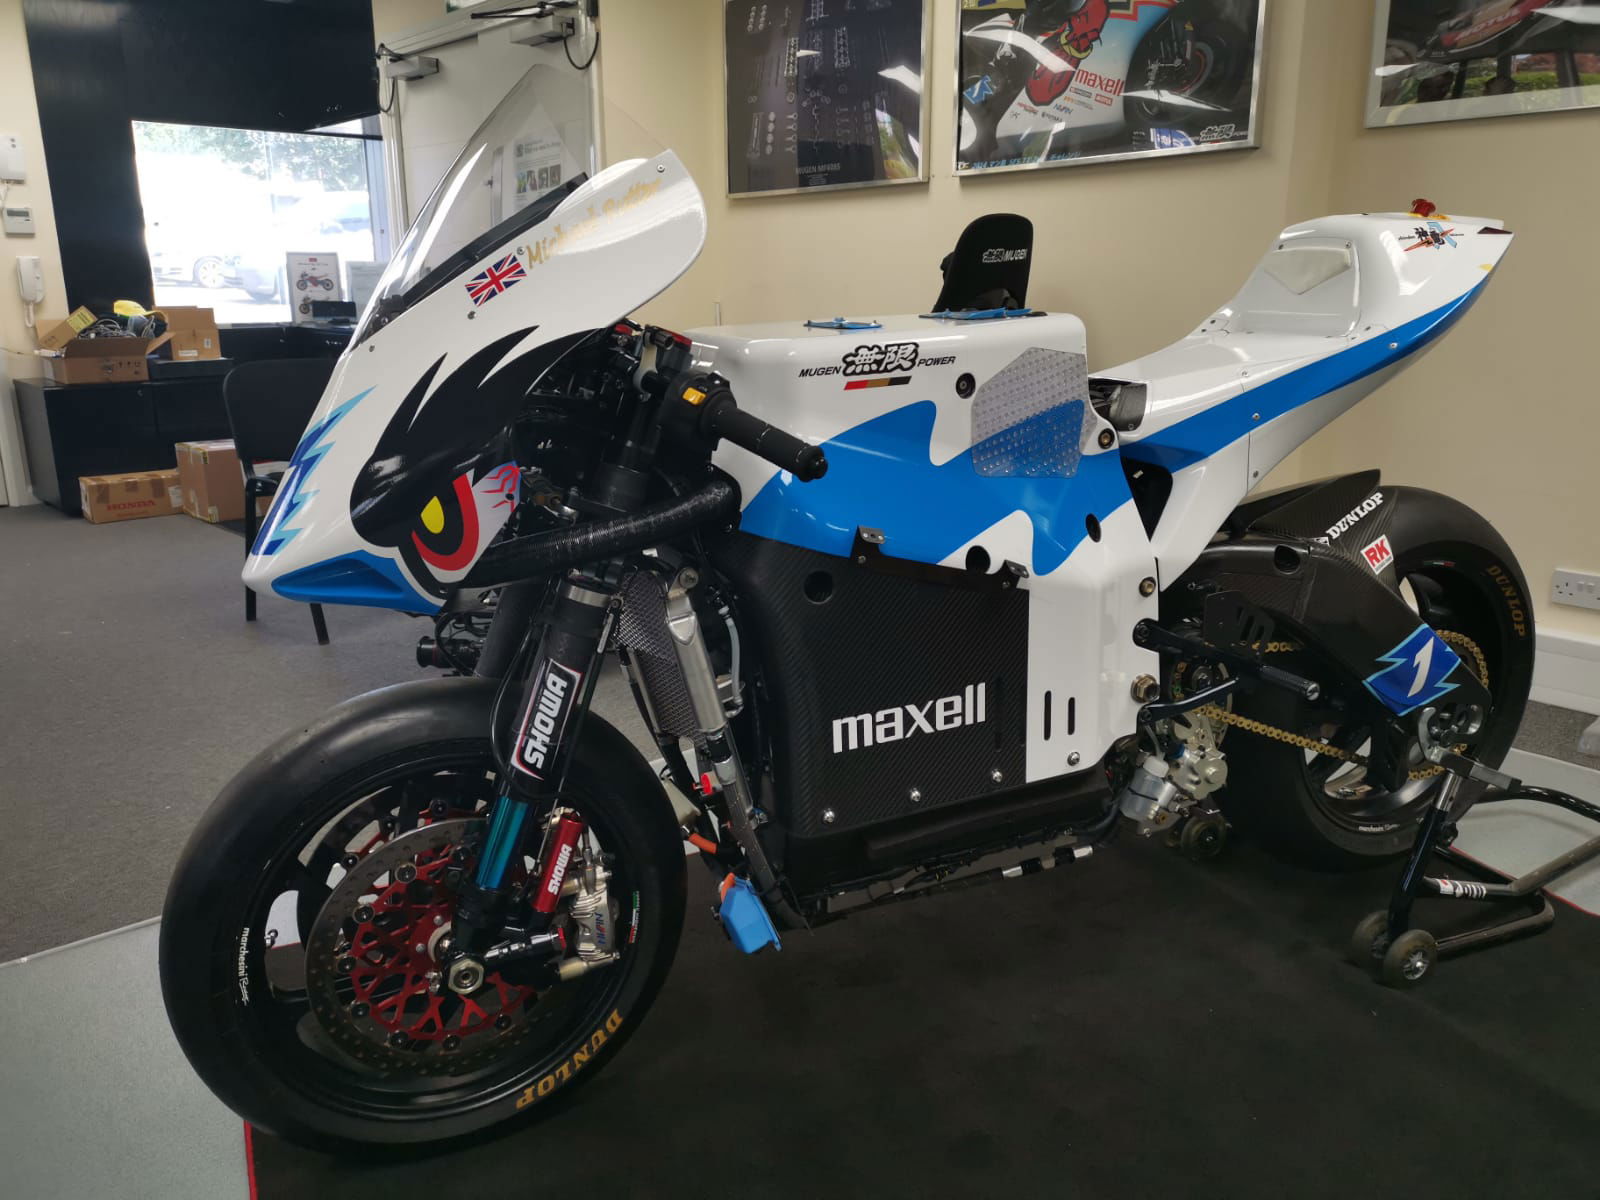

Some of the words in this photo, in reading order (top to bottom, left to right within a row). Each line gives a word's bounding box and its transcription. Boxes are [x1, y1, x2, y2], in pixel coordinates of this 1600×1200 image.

[1075, 68, 1125, 97] maxell
[1004, 248, 1028, 262] MUGEN
[799, 366, 842, 378] MUGEN
[842, 342, 919, 376] 無限
[917, 356, 956, 367] POWER
[1325, 492, 1383, 540] DUNLOP
[1364, 539, 1391, 568] RK
[1487, 565, 1525, 636] DUNLOP
[1407, 637, 1434, 698] 1
[524, 673, 567, 769] SHOWA
[832, 682, 986, 754] maxell
[548, 843, 572, 895] SHOWA
[238, 927, 250, 977] marchesini
[516, 1008, 623, 1109] DUNLOP
